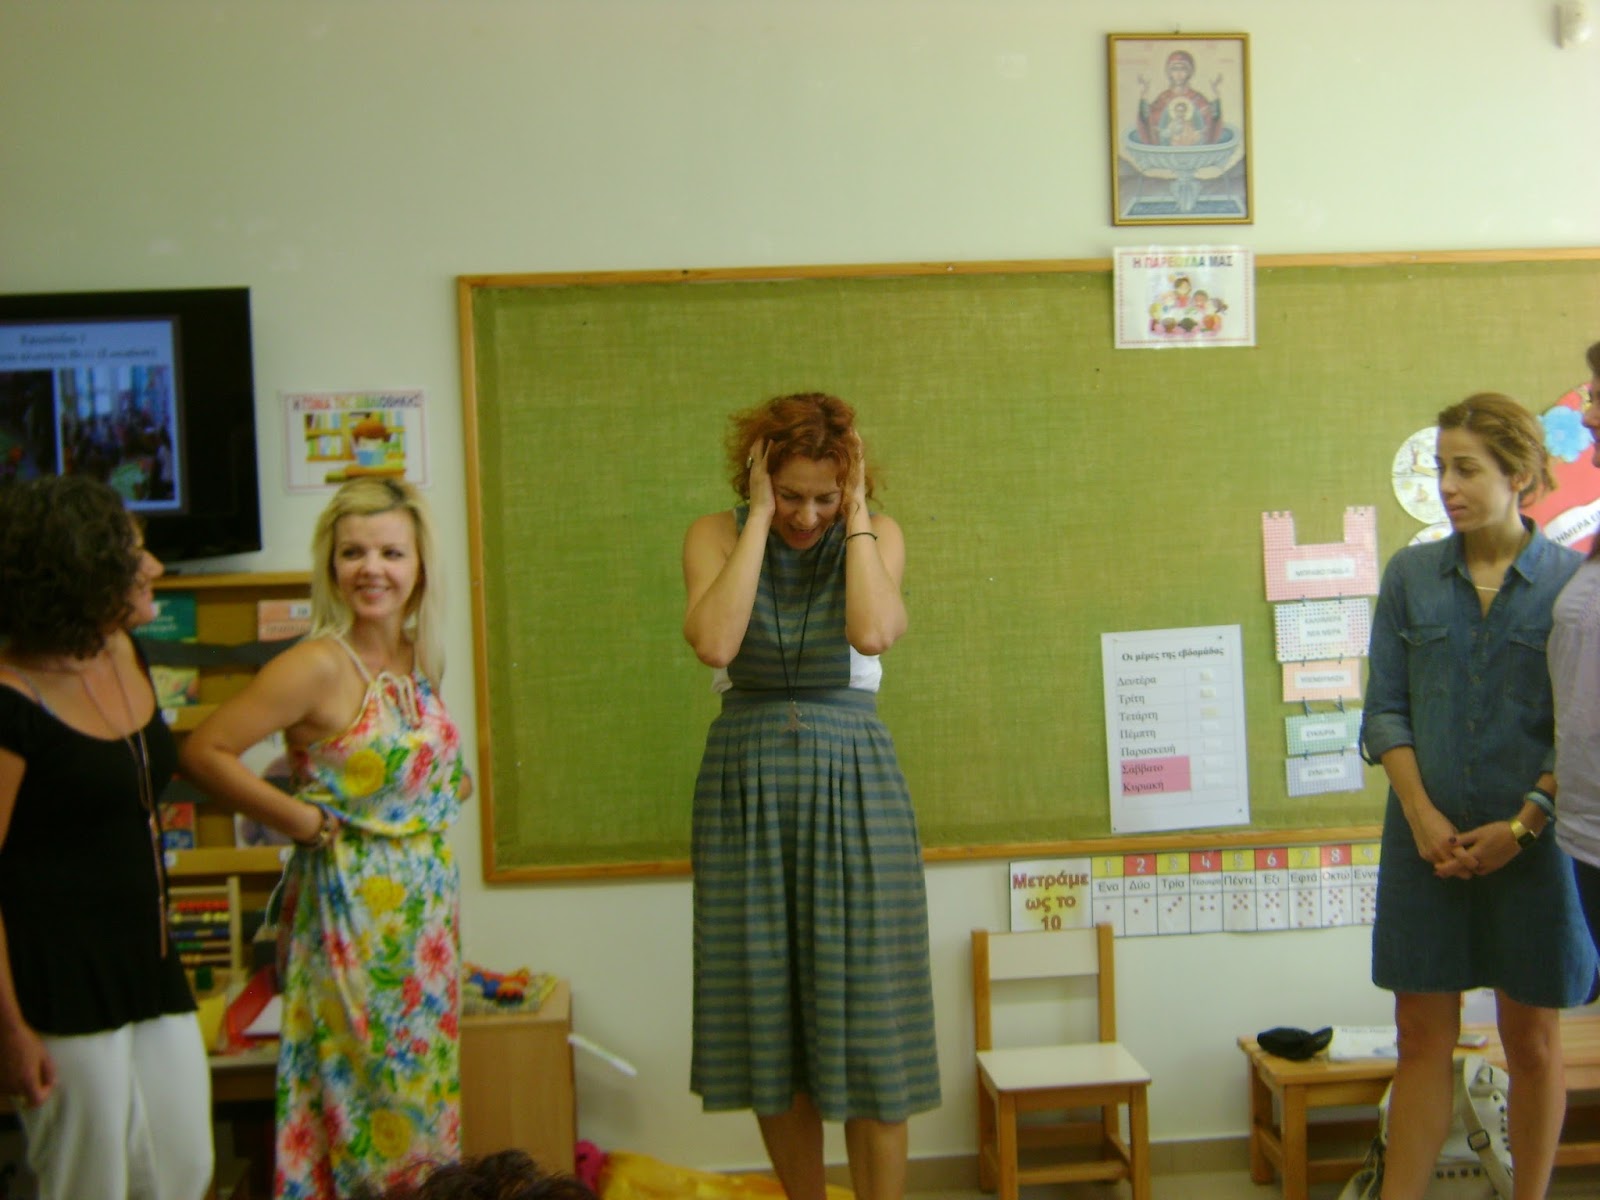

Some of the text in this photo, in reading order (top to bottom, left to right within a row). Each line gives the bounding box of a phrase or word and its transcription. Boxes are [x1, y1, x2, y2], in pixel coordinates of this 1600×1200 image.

[1132, 257, 1141, 268] Η
[1209, 255, 1233, 267] ΜΑΣ
[1121, 652, 1133, 661] Οι
[1135, 651, 1159, 662] μέρες
[1161, 651, 1176, 660] της
[1118, 676, 1156, 687] Δευτέρα
[1119, 693, 1145, 705] Τρίτη
[1119, 711, 1158, 722] Τετάρτη
[1120, 729, 1156, 740] Πέμπτη
[1120, 744, 1176, 757] Παρασκευή
[1121, 763, 1163, 775] Σάββατο
[1123, 781, 1164, 792] Κυριακή
[1105, 847, 1374, 873] 1 2 3 4 5 6 7 8 9
[1013, 870, 1089, 890] Μετράμε
[1129, 879, 1150, 890] Δύο
[1162, 878, 1185, 889] Τρία
[1224, 875, 1252, 887] Πέντε
[1025, 895, 1076, 913] ως το
[1041, 915, 1062, 931] 10
